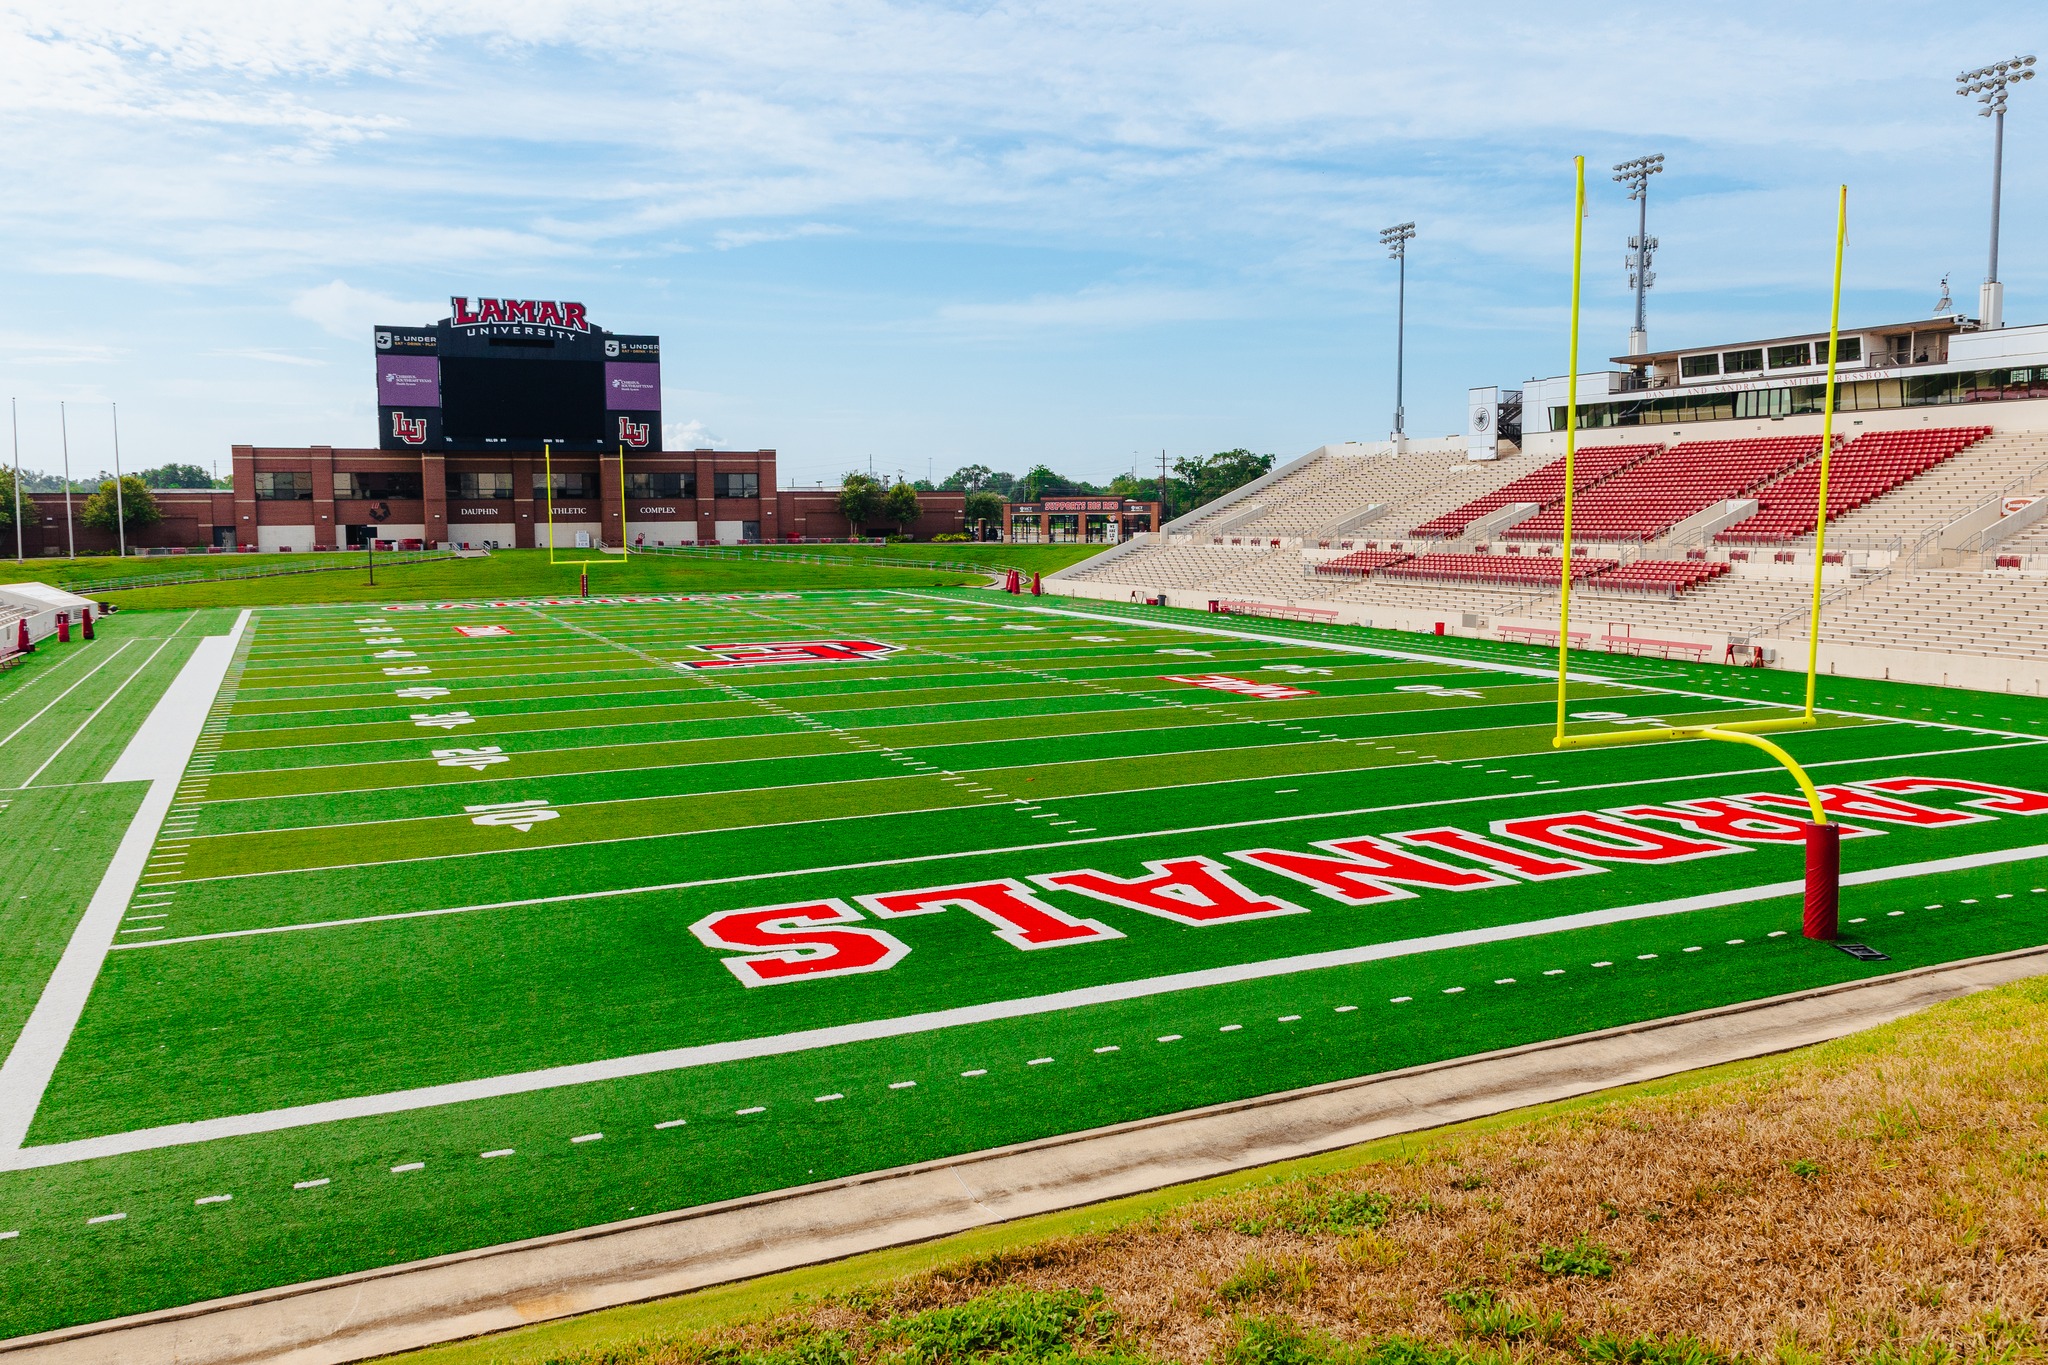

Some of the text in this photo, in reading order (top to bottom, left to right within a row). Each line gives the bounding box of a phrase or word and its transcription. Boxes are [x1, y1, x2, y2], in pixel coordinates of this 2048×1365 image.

[451, 296, 590, 334] LAMAR
[466, 326, 575, 341] UNIVERSITY
[1687, 387, 1707, 395] AND
[1715, 383, 1756, 393] SANDRA
[1783, 377, 1819, 387] SMITH
[1836, 370, 1890, 382] RESSBOX
[392, 411, 427, 444] LU
[619, 416, 650, 447] LU
[640, 506, 676, 514] COMPLEX
[1045, 501, 1119, 511] SUPPORTS BIG RED
[432, 746, 511, 767] 20
[464, 800, 561, 826] 10
[688, 776, 2048, 988] CARDINALS
